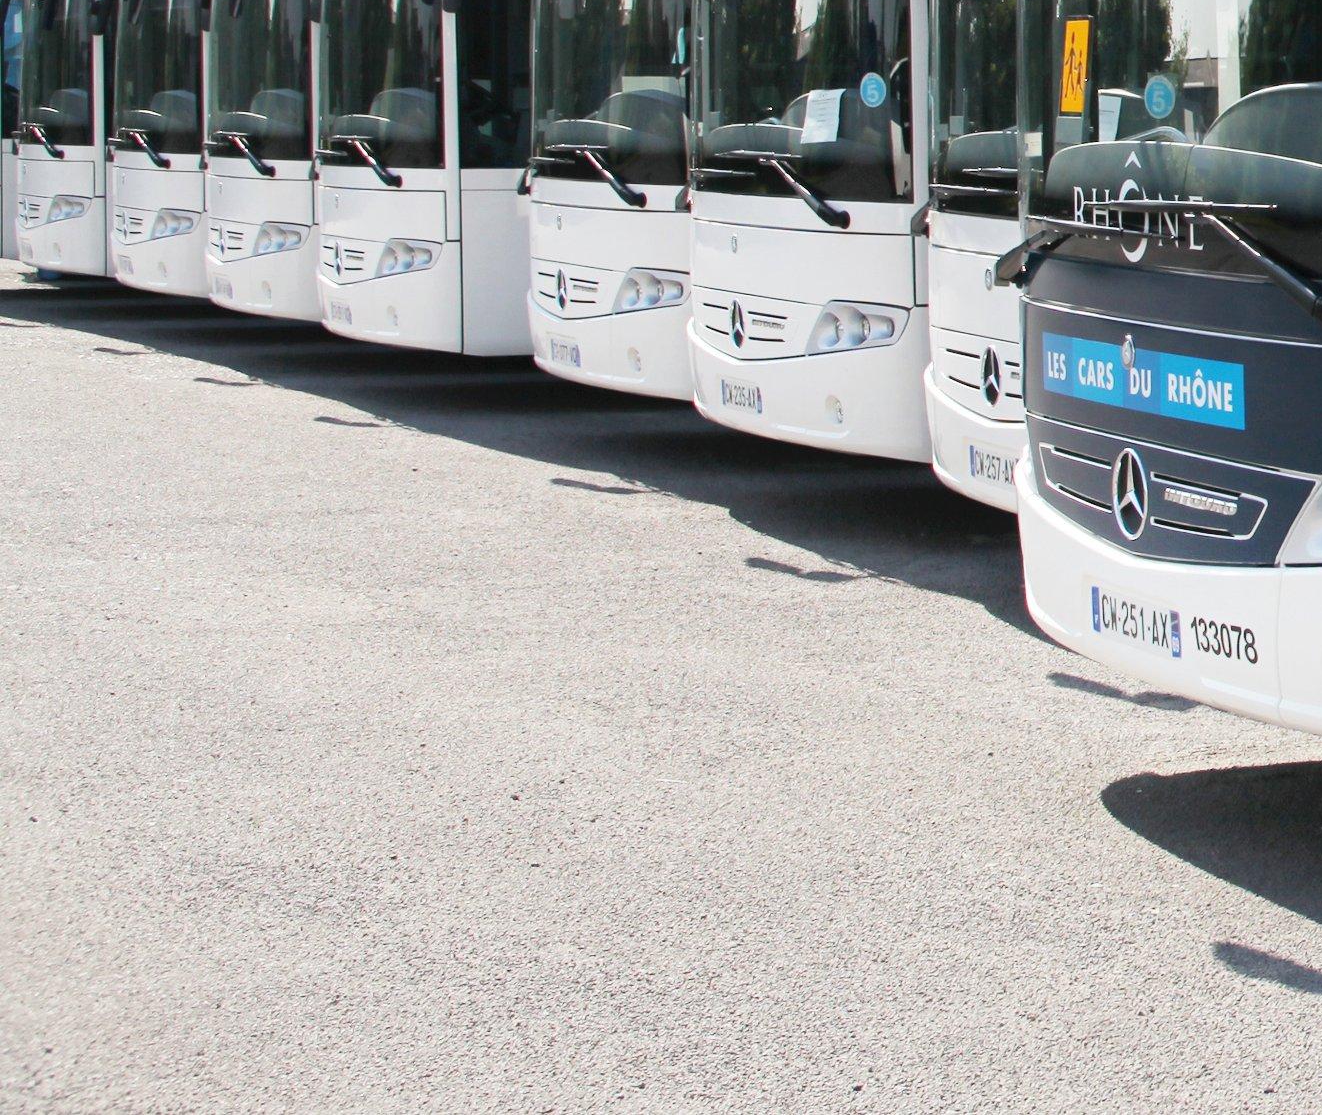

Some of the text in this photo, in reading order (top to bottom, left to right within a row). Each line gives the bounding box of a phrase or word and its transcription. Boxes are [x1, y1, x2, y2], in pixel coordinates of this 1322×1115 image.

[1073, 150, 1204, 263] RHÔNE
[1047, 351, 1234, 413] LES CARS DU RHÔNE
[1101, 593, 1170, 649] CW-251-AX
[1190, 616, 1259, 665] 133078
